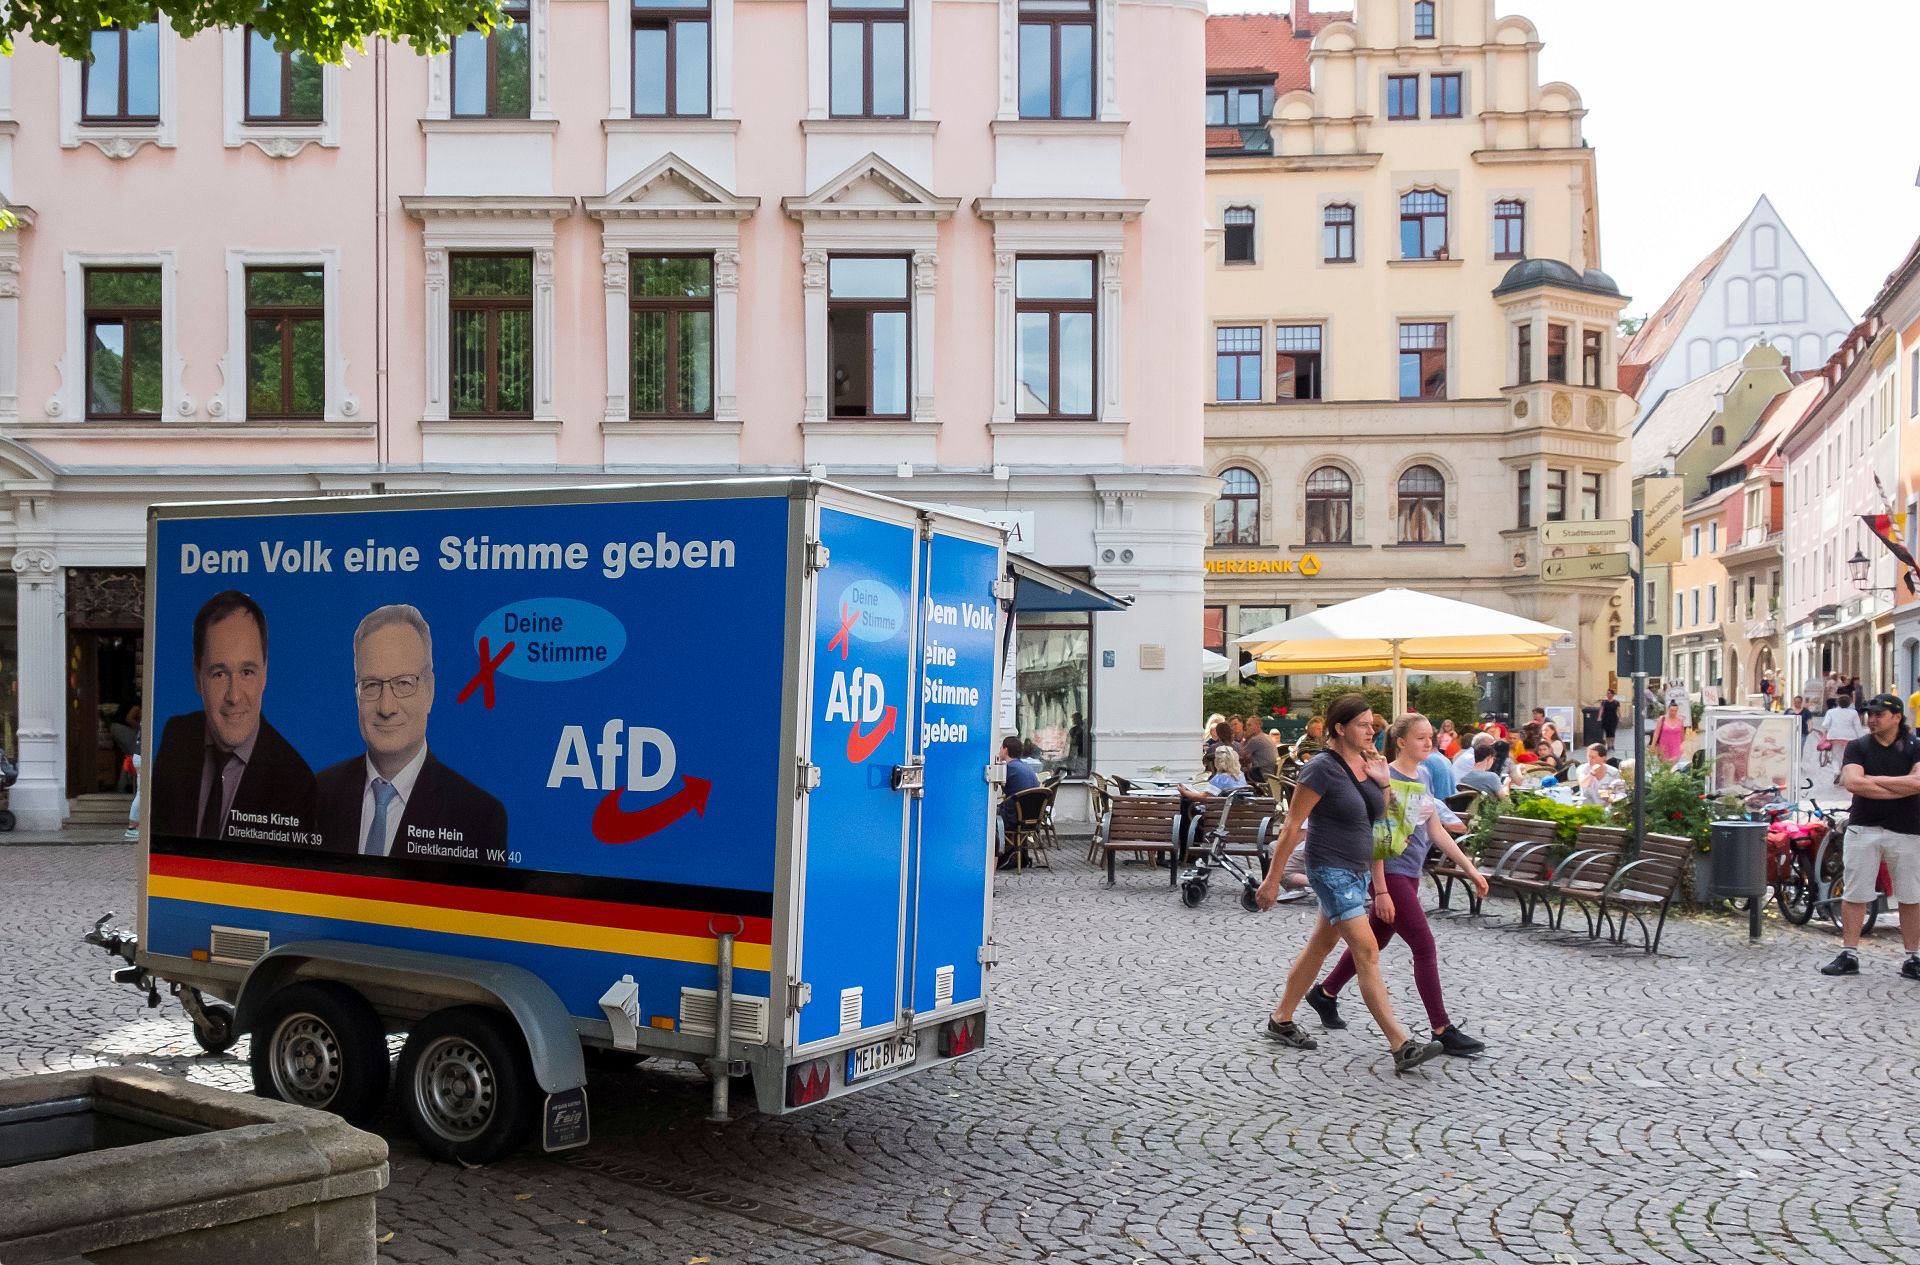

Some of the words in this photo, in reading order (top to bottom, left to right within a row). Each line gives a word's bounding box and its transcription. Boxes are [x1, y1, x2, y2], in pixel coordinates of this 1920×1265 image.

[1562, 529, 1616, 538] Stadtmuseum
[180, 543, 249, 574] Dem
[260, 540, 333, 573] Volk
[344, 539, 420, 572] eine
[438, 535, 589, 571] Stimme
[602, 531, 735, 579] geben
[1589, 562, 1605, 571] WC
[852, 587, 879, 607] Deine
[504, 611, 563, 634] Deine
[862, 610, 896, 630] Stimme
[923, 596, 957, 626] Dem
[962, 602, 993, 631] Volk
[527, 641, 608, 663] Stimme
[925, 639, 956, 667] eine
[825, 666, 885, 723] AfD
[924, 677, 979, 707] Stimme
[923, 717, 968, 749] geben
[546, 718, 677, 792] AfD
[230, 809, 268, 824] Thomas
[270, 812, 300, 827] Kirste
[228, 825, 290, 843] Direktkandidat
[292, 831, 309, 845] WK
[310, 833, 323, 846] 39
[407, 825, 435, 839] Rene
[438, 827, 464, 841] Hein
[407, 841, 479, 859] Direktkandidat
[486, 848, 506, 862] WK
[507, 851, 522, 864] 40
[855, 1047, 875, 1074] MEI
[883, 1043, 897, 1066] BV
